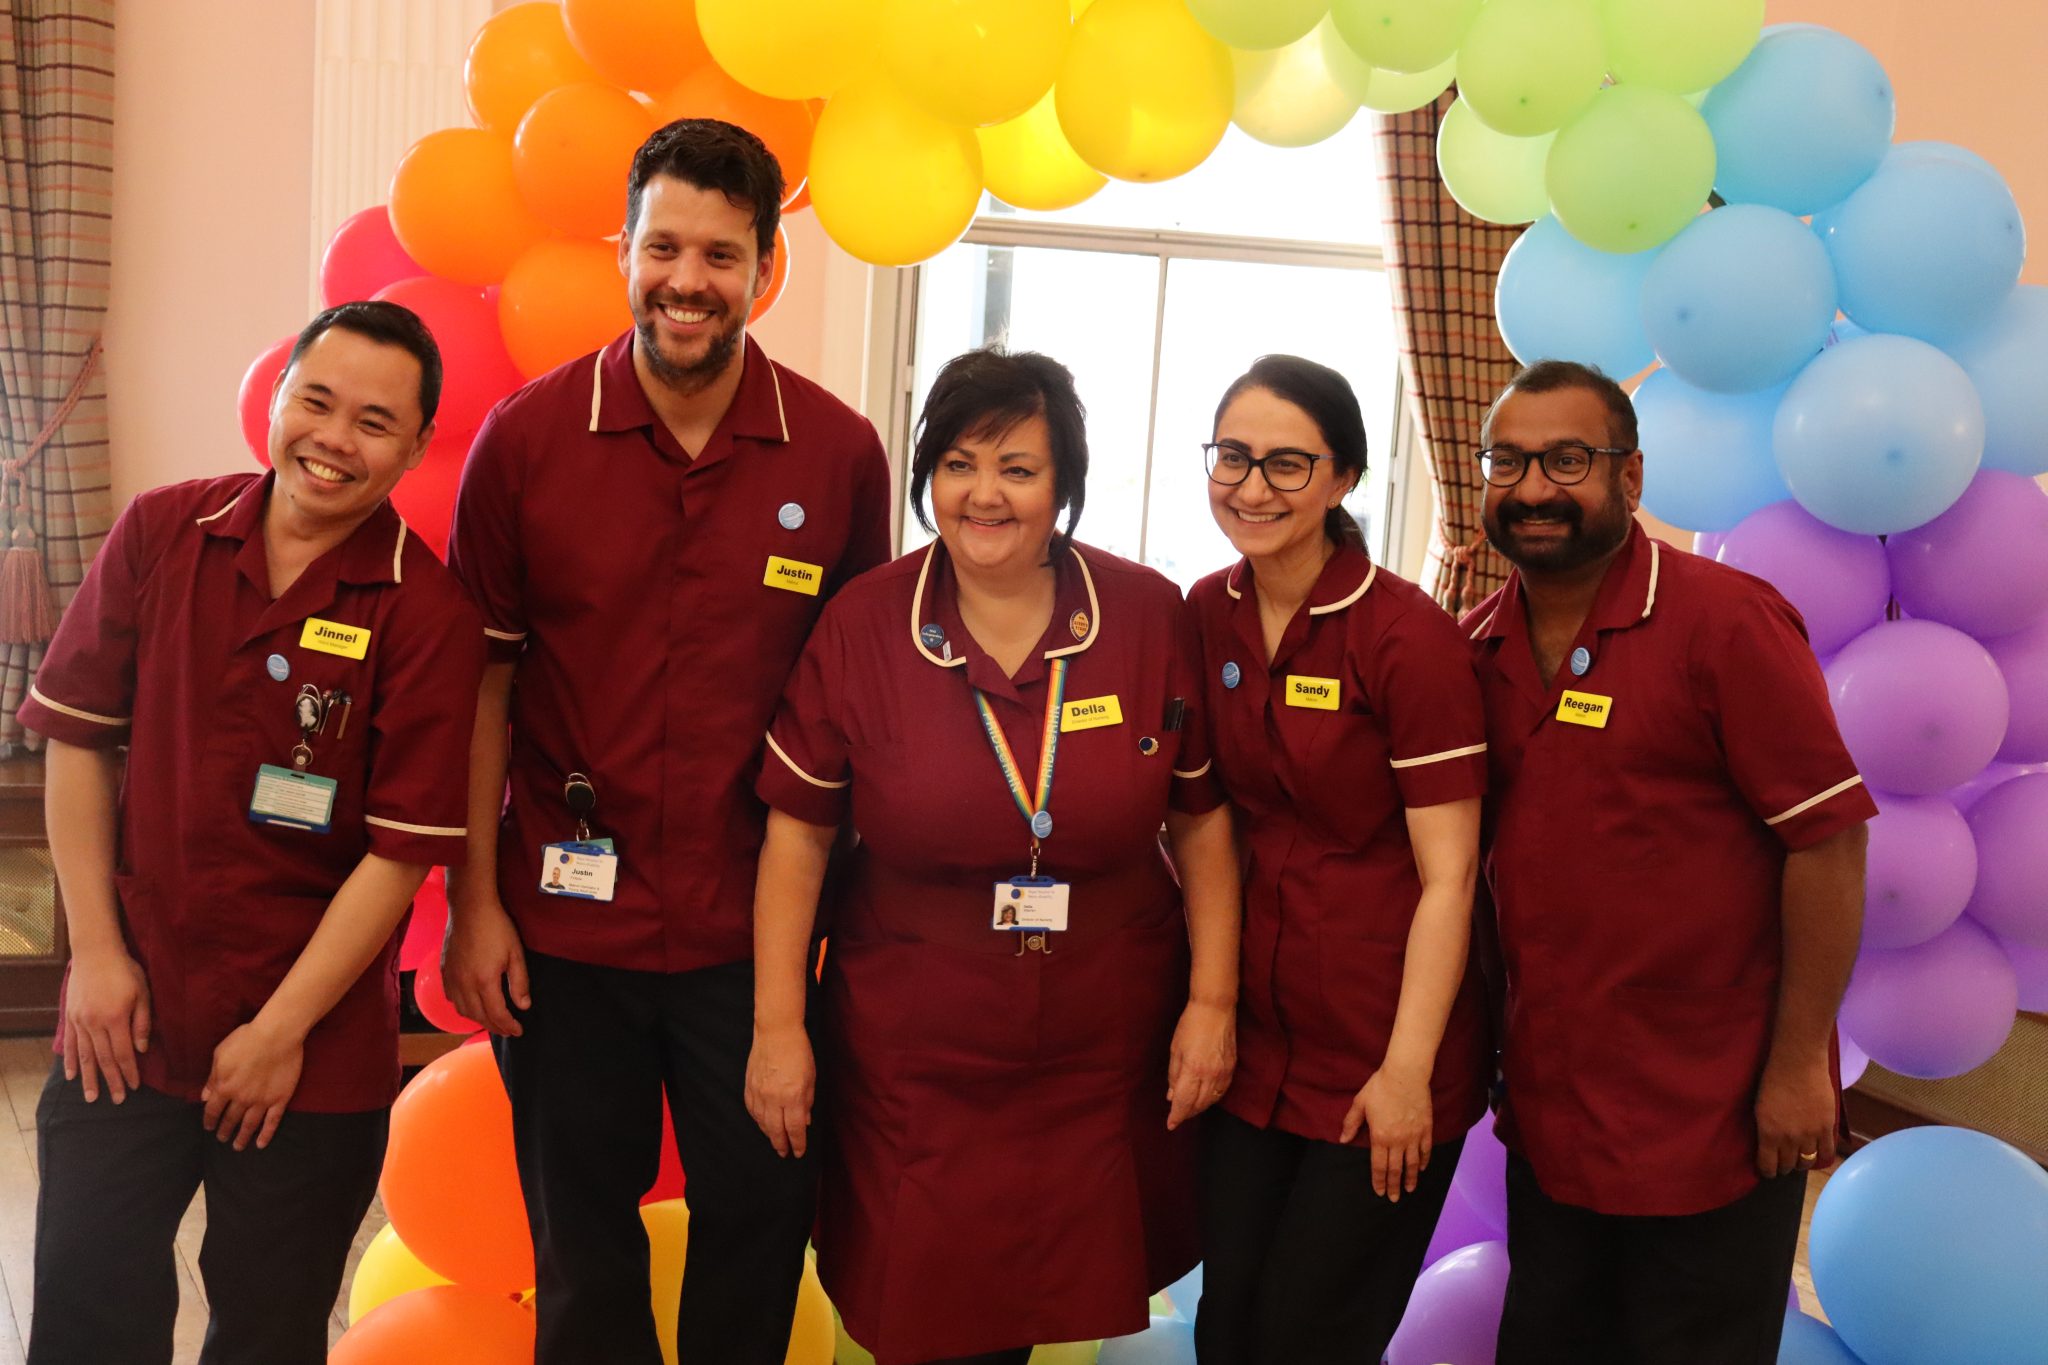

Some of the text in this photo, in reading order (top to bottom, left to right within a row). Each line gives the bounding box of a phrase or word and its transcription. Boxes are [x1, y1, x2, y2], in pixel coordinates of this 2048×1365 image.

[777, 565, 813, 581] Justin
[315, 626, 358, 643] Jinnel
[1295, 682, 1330, 698] Sandy
[1071, 704, 1106, 717] Della
[1564, 697, 1604, 713] Reegan
[1040, 704, 1061, 788] PRIDE@RHN
[572, 868, 593, 877] Justin
